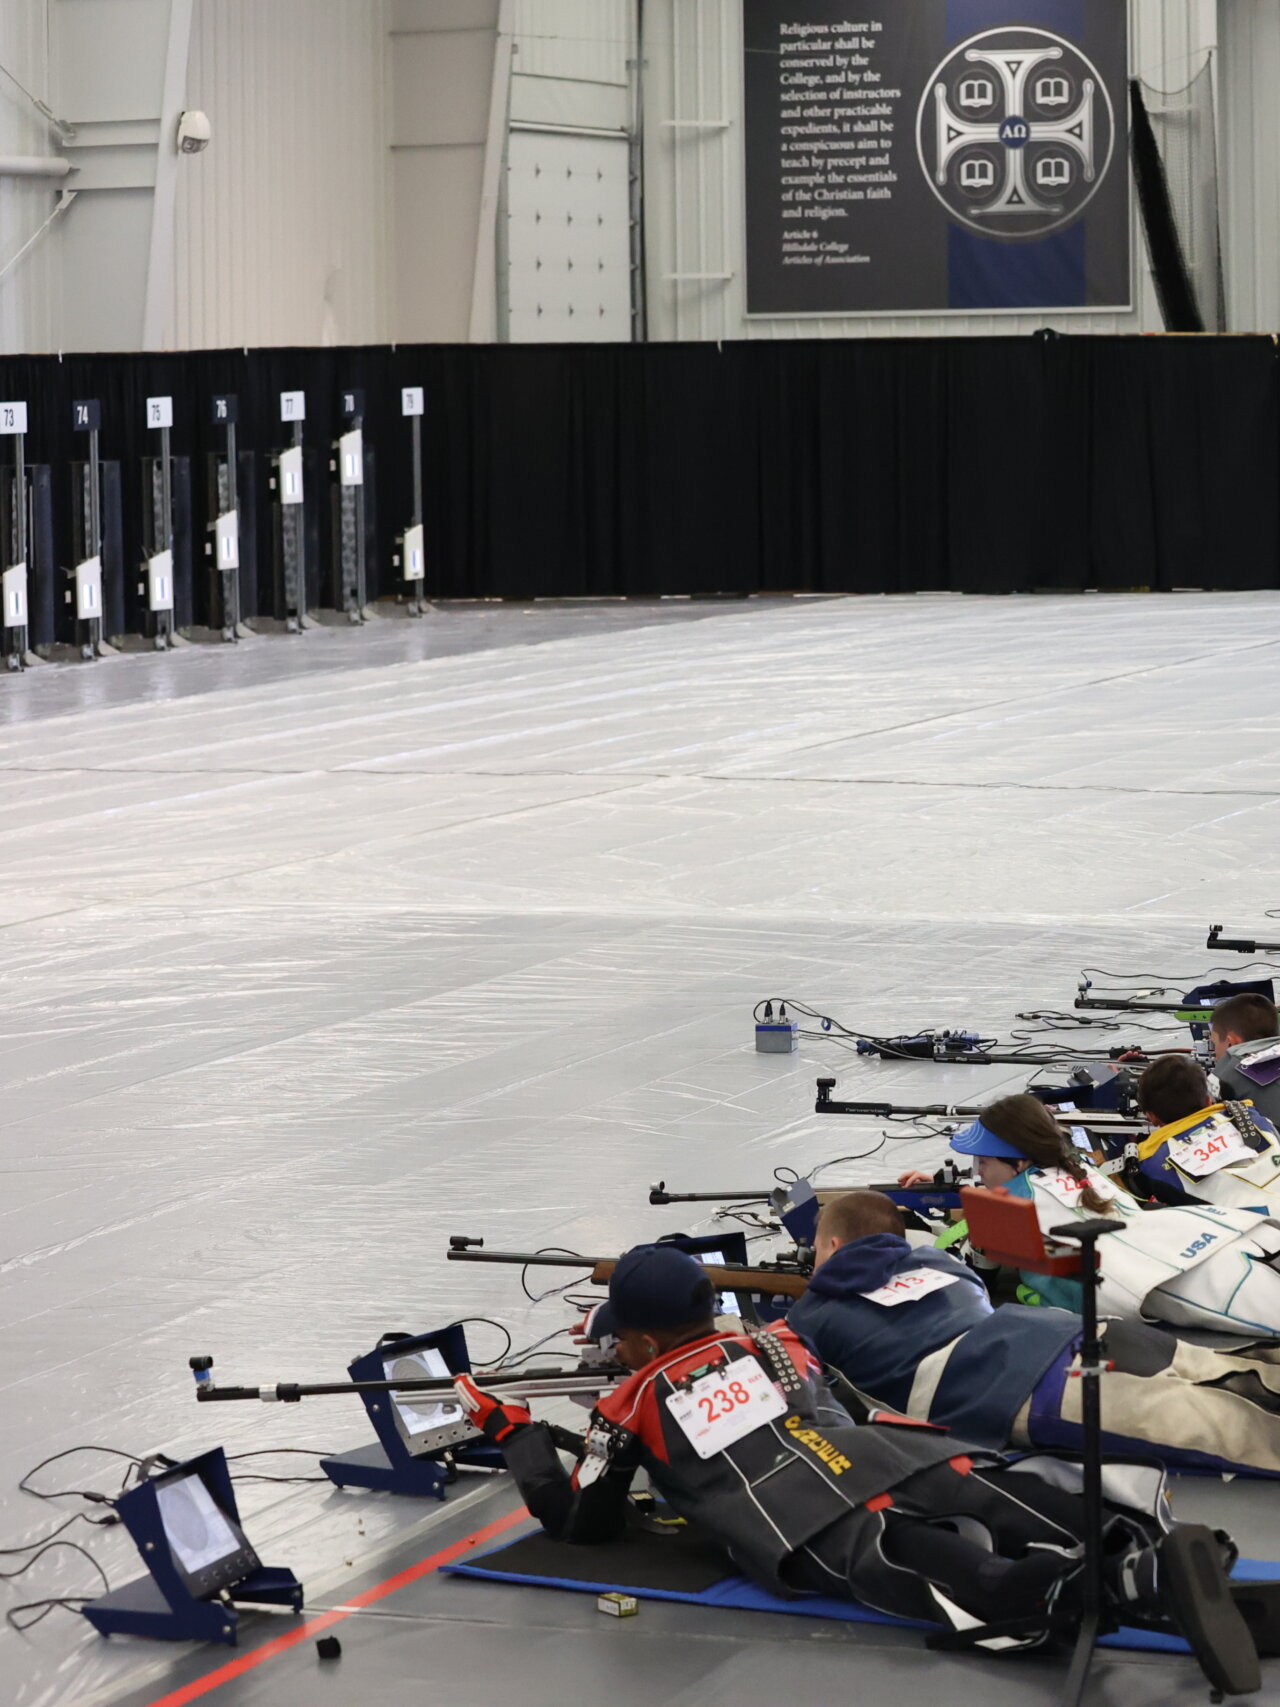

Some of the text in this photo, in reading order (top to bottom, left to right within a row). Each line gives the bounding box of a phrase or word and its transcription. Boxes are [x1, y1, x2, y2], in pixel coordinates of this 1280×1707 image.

[780, 20, 883, 38] Religious culture in
[780, 36, 876, 54] particular shall be
[835, 54, 849, 69] by
[851, 53, 869, 66] the
[780, 70, 881, 87] College, and by the
[780, 87, 901, 101] selection of instructors
[780, 106, 801, 118] and
[802, 105, 832, 117] other
[842, 122, 850, 133] it
[852, 120, 878, 132] shall
[880, 120, 894, 132] be
[781, 142, 788, 151] a
[857, 138, 878, 149] aim
[880, 139, 892, 149] to
[781, 155, 810, 168] teach
[811, 155, 825, 170] by
[868, 153, 889, 165] and
[827, 172, 845, 183] the
[781, 186, 892, 201] of the Christian faith
[782, 206, 848, 220] and religion.
[4, 408, 15, 427] 73
[77, 406, 88, 424] 74
[152, 404, 161, 422] 75
[1193, 1135, 1228, 1162] 347
[1055, 1175, 1092, 1192] 22
[1180, 1231, 1218, 1260] USA
[697, 1380, 751, 1424] 238
